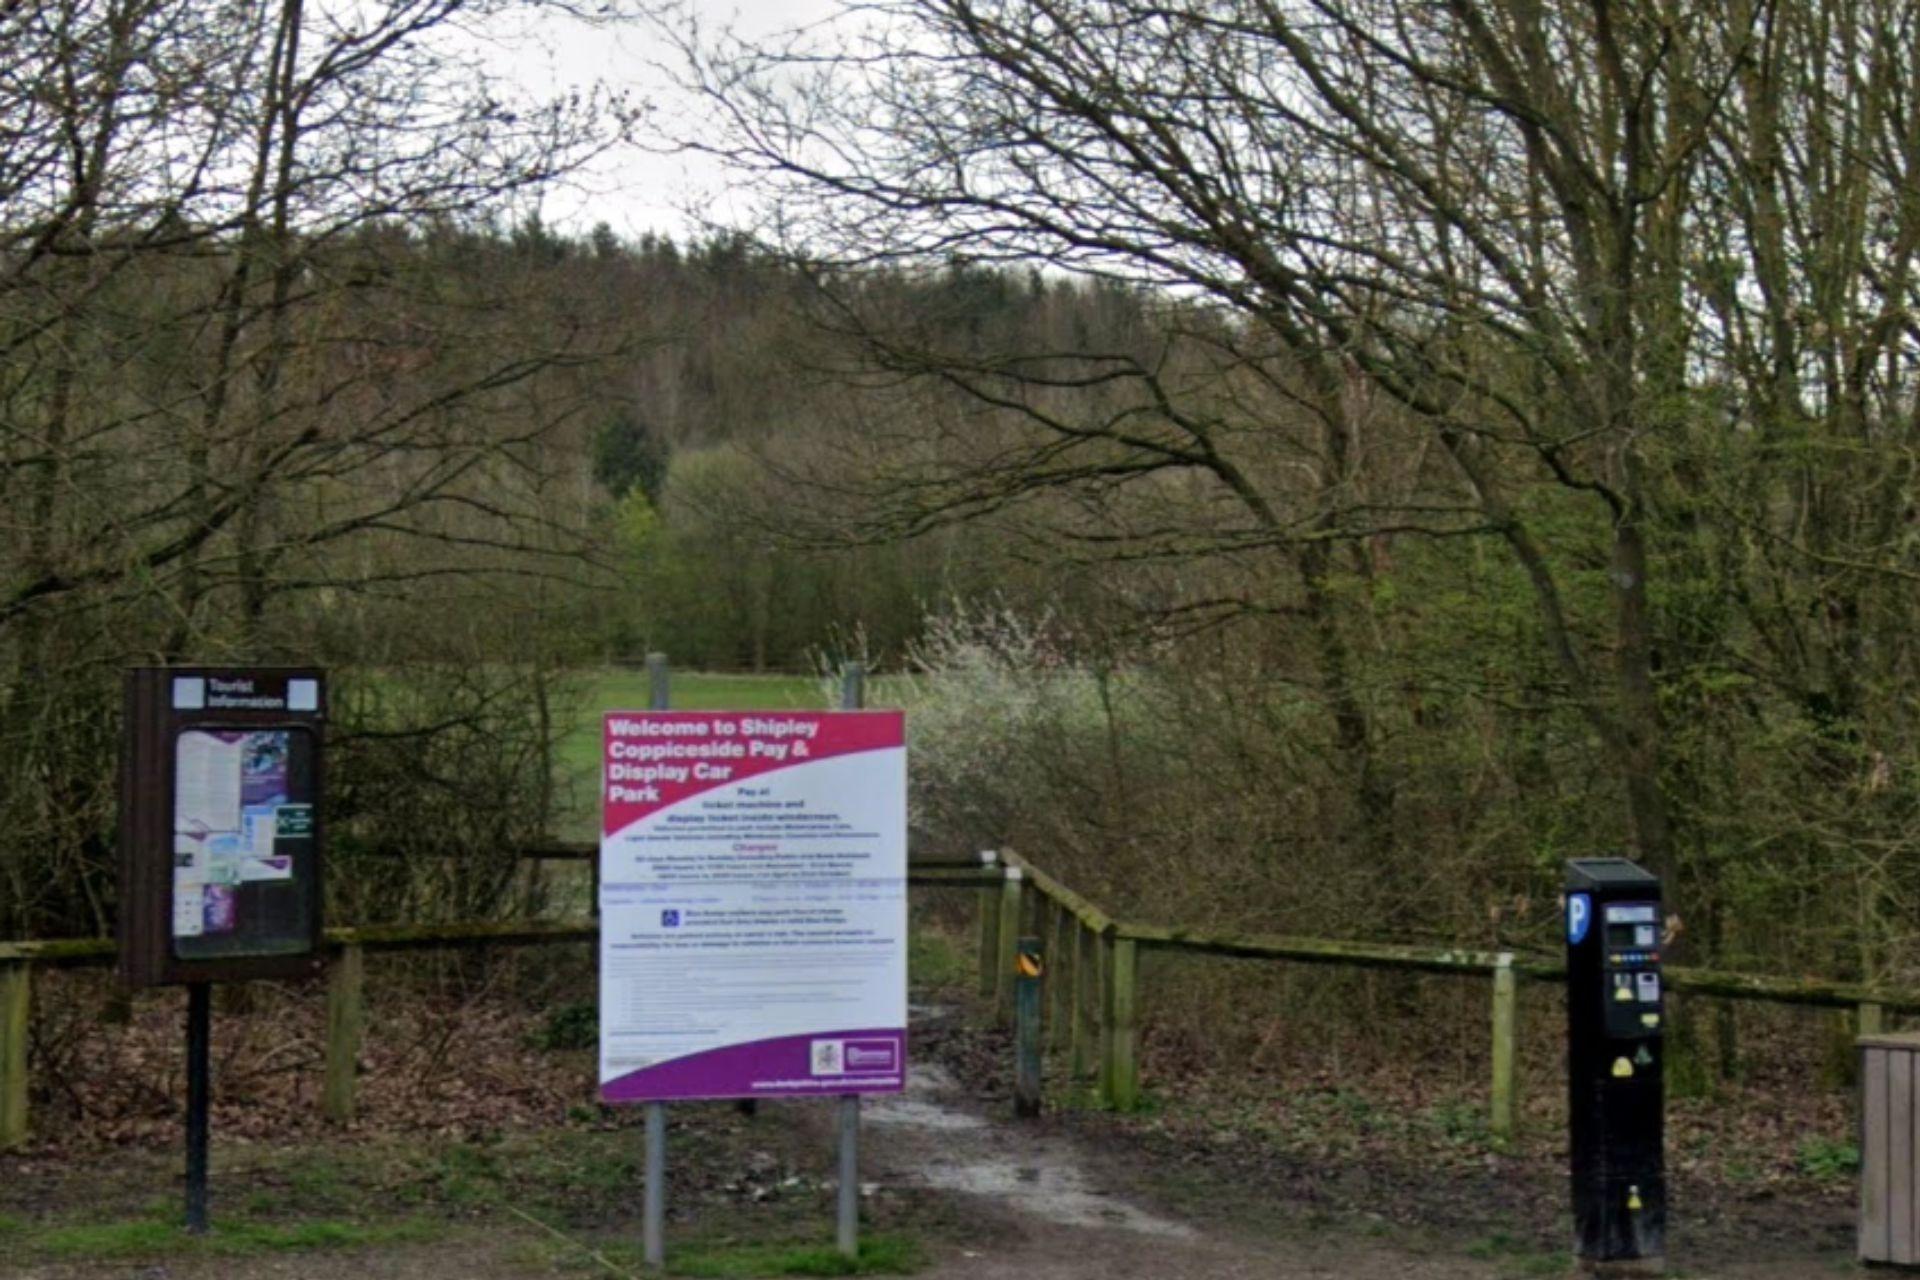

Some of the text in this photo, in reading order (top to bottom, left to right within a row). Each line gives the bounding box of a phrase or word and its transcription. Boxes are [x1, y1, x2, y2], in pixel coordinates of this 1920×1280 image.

[608, 719, 818, 740] Welcome to Shipley
[608, 740, 809, 760] Coppiceside Pay &
[608, 763, 731, 782] Display Car
[609, 785, 659, 802] Park
[1568, 897, 1585, 935] P
